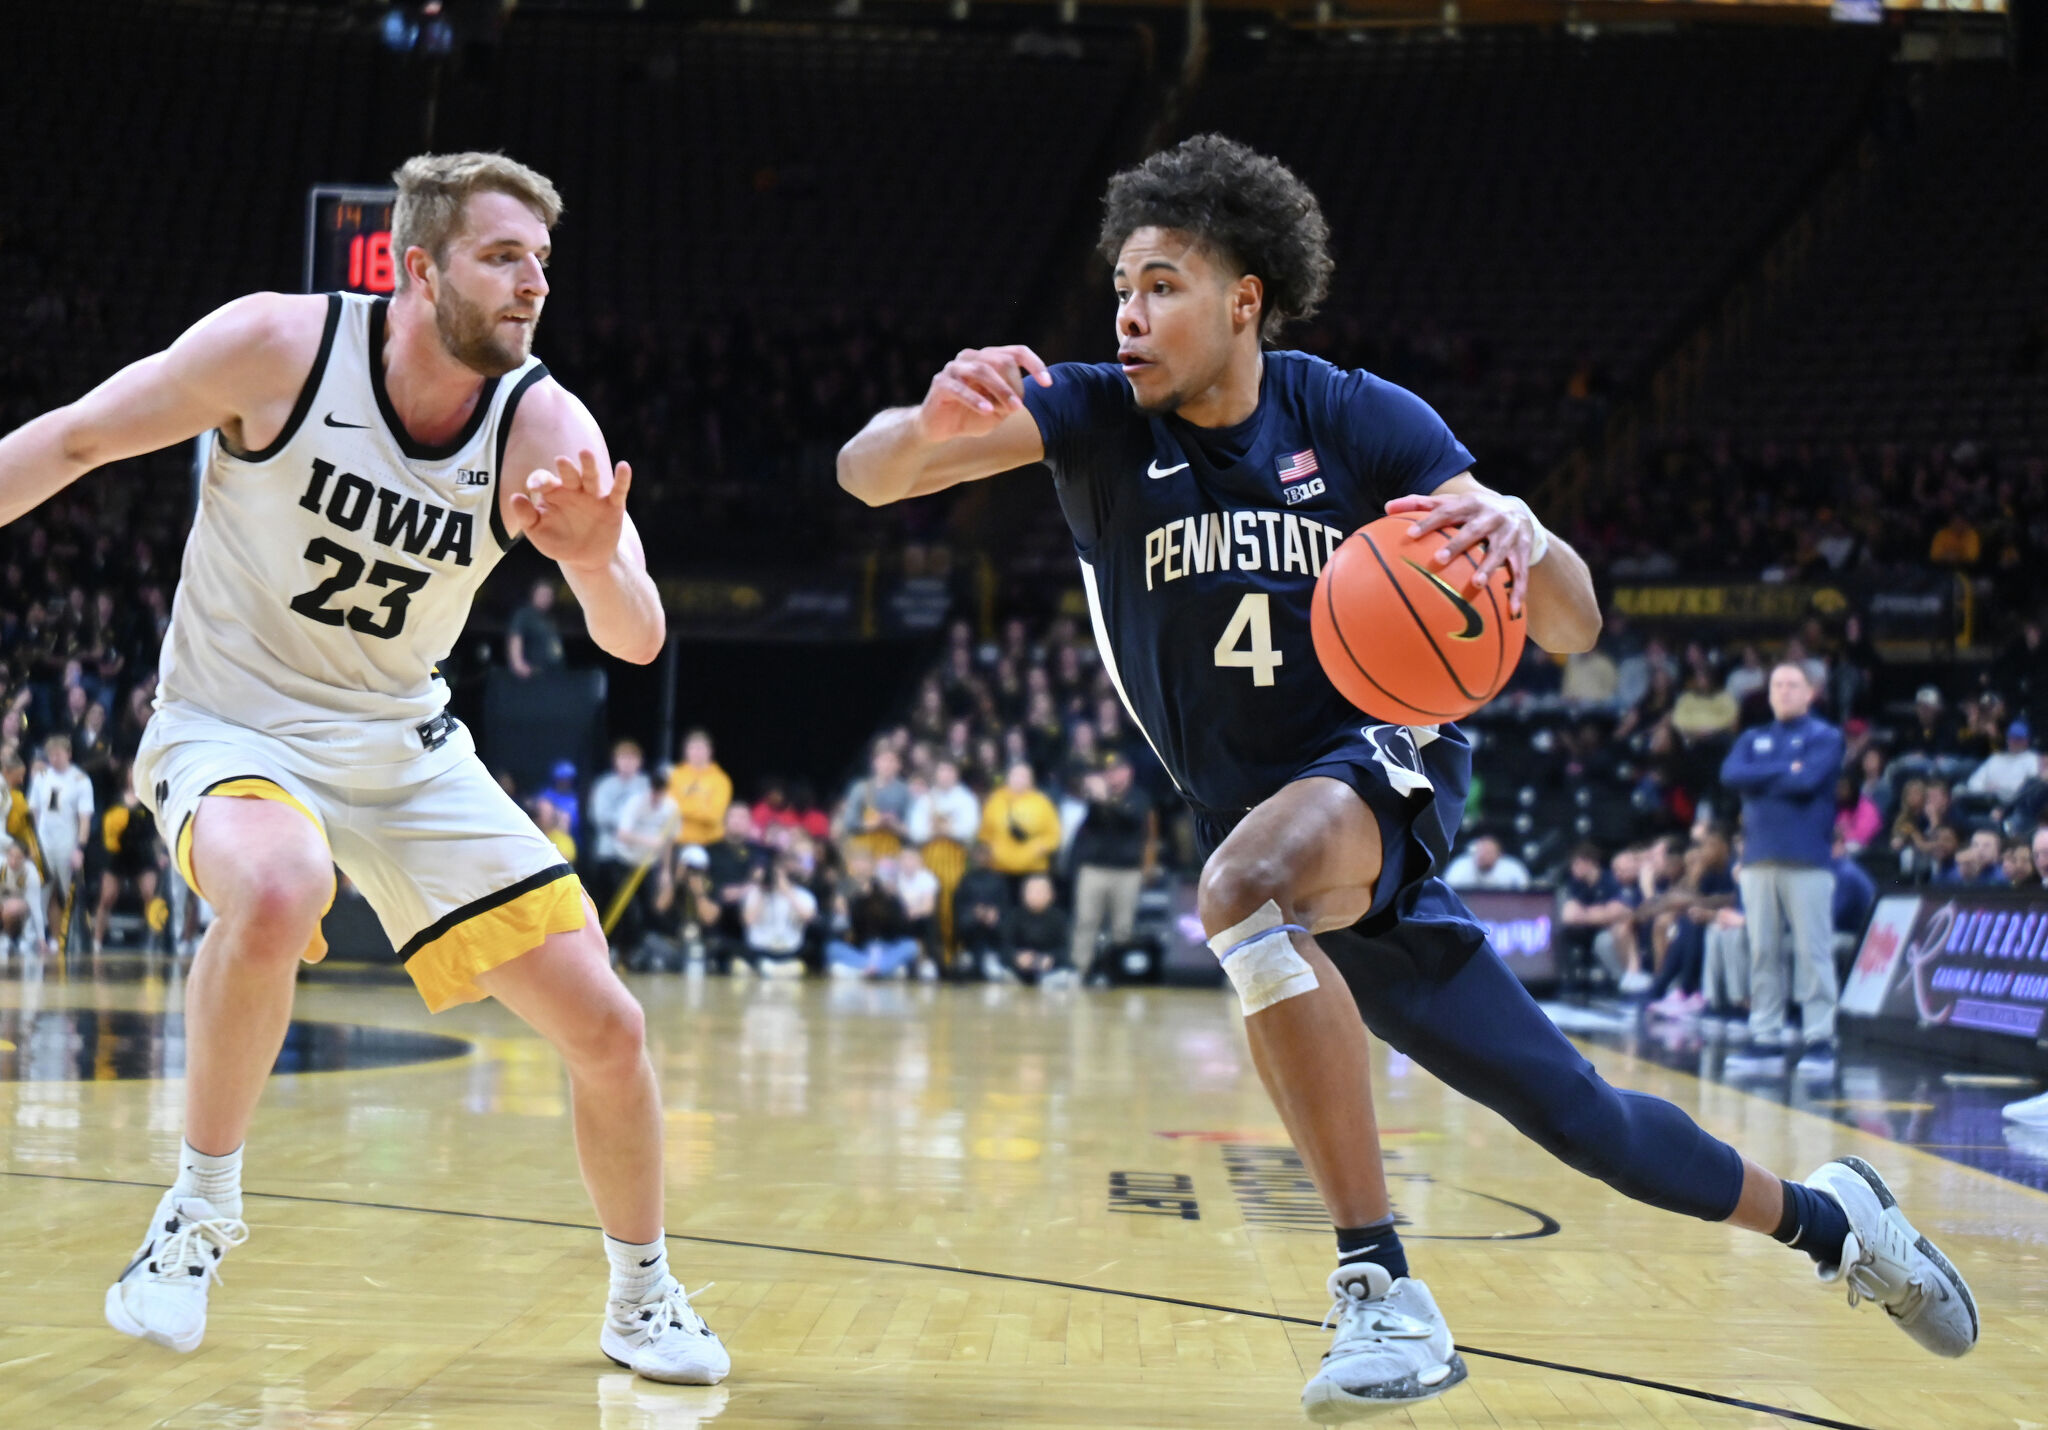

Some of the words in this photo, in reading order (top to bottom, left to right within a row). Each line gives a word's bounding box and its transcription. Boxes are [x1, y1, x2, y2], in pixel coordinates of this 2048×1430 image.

[298, 457, 473, 566] IOWA
[1146, 511, 1230, 591] PENN
[290, 536, 431, 639] 23
[1214, 593, 1283, 687] 4
[2010, 973, 2048, 999] RESOR
